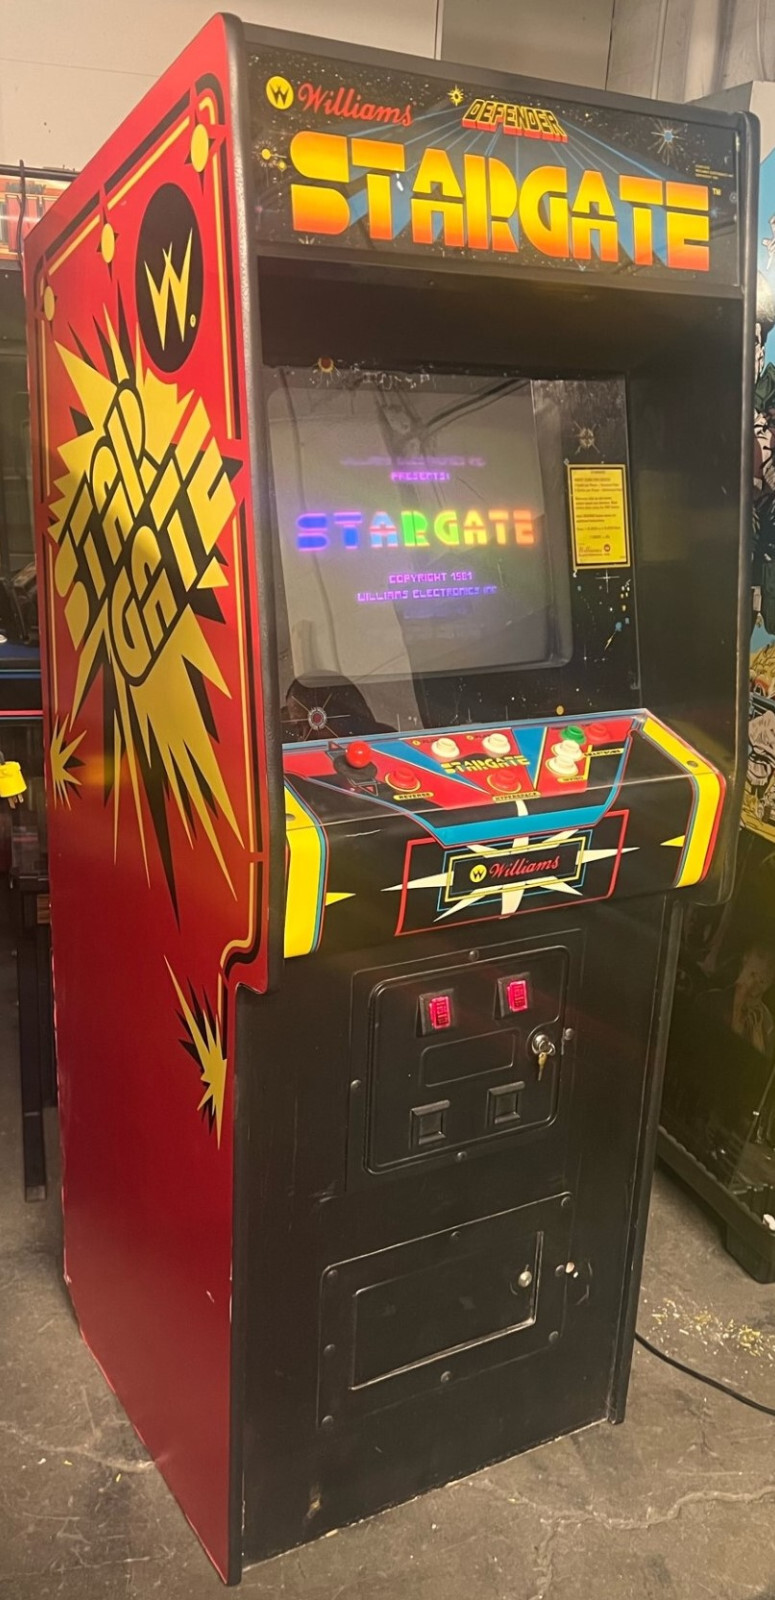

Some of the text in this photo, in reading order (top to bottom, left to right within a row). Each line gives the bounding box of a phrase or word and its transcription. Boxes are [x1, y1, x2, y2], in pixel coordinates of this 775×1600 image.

[268, 82, 413, 127] W Williams
[462, 99, 568, 143] DEFENDER
[289, 130, 710, 271] STARGATE
[296, 510, 535, 551] STARGATE
[357, 589, 409, 602] WILLIAMS
[412, 586, 480, 599] ELECTRONICS
[389, 572, 447, 584] COPYRIGHT
[440, 755, 531, 774] STARGATE
[489, 855, 560, 878] Williams
